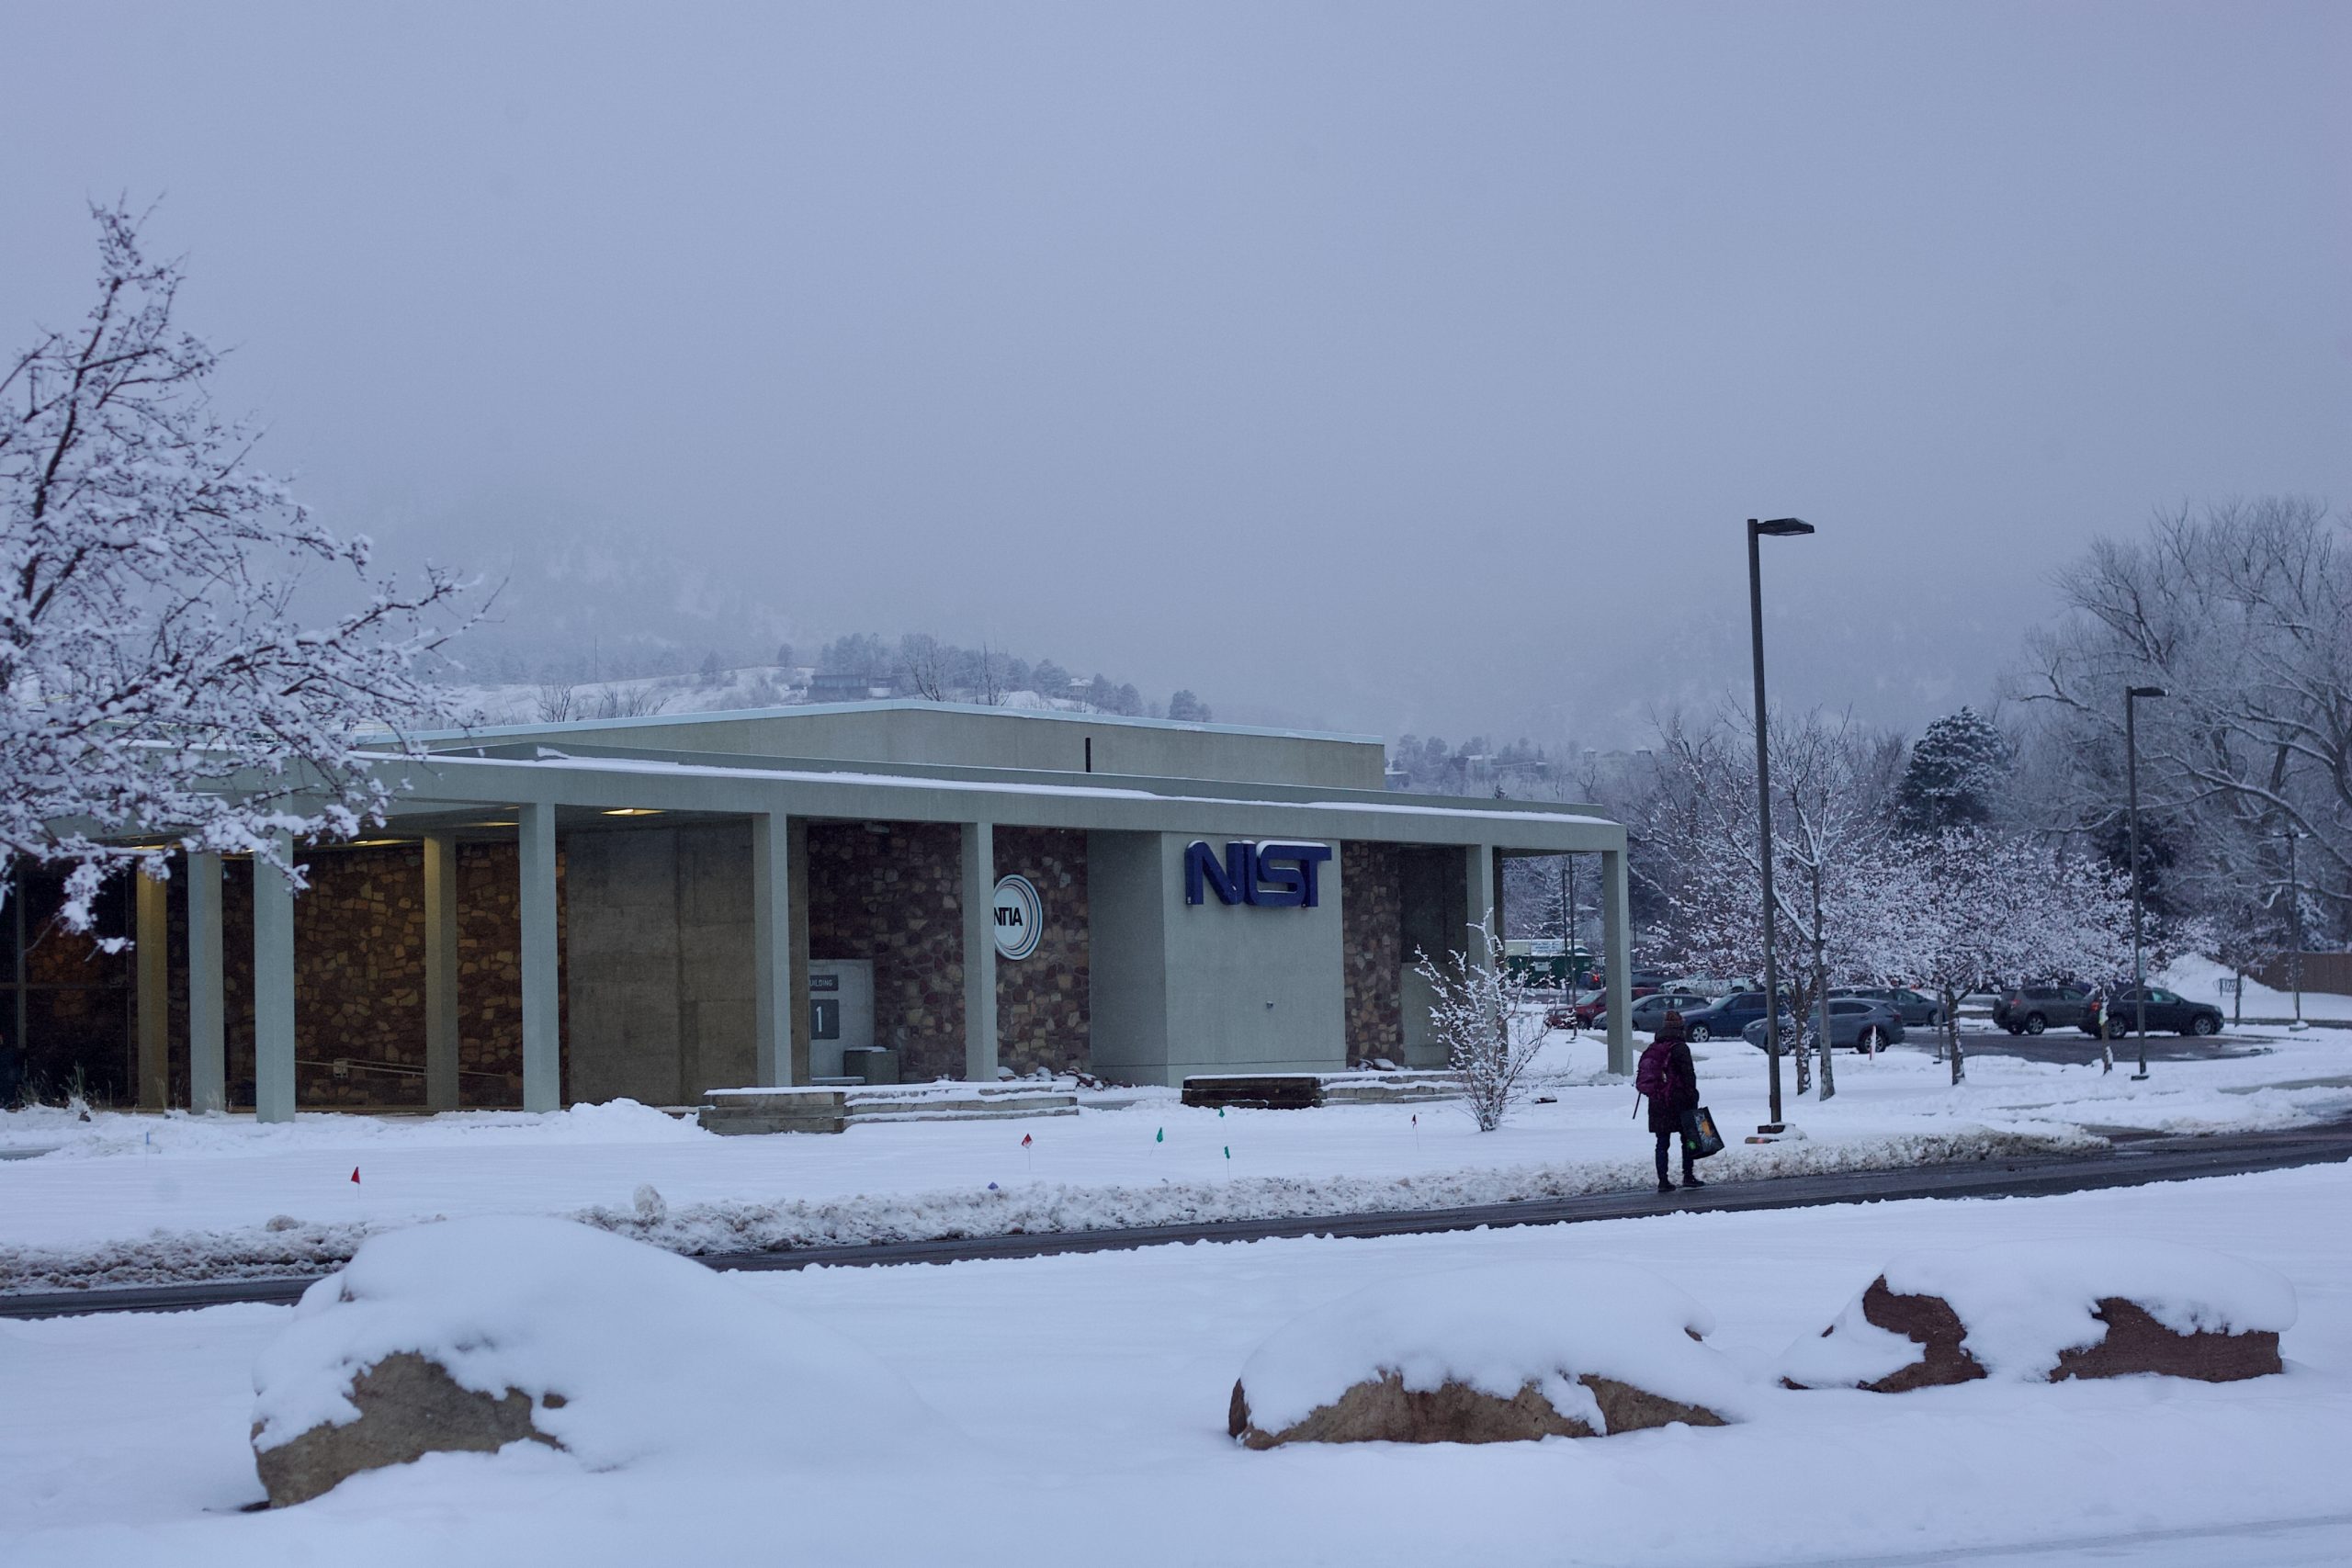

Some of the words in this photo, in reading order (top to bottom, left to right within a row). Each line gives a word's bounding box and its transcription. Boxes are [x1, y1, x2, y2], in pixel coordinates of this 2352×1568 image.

[1184, 840, 1332, 908] NIST
[993, 907, 1023, 927] NTIA
[816, 1006, 822, 1032] 1
